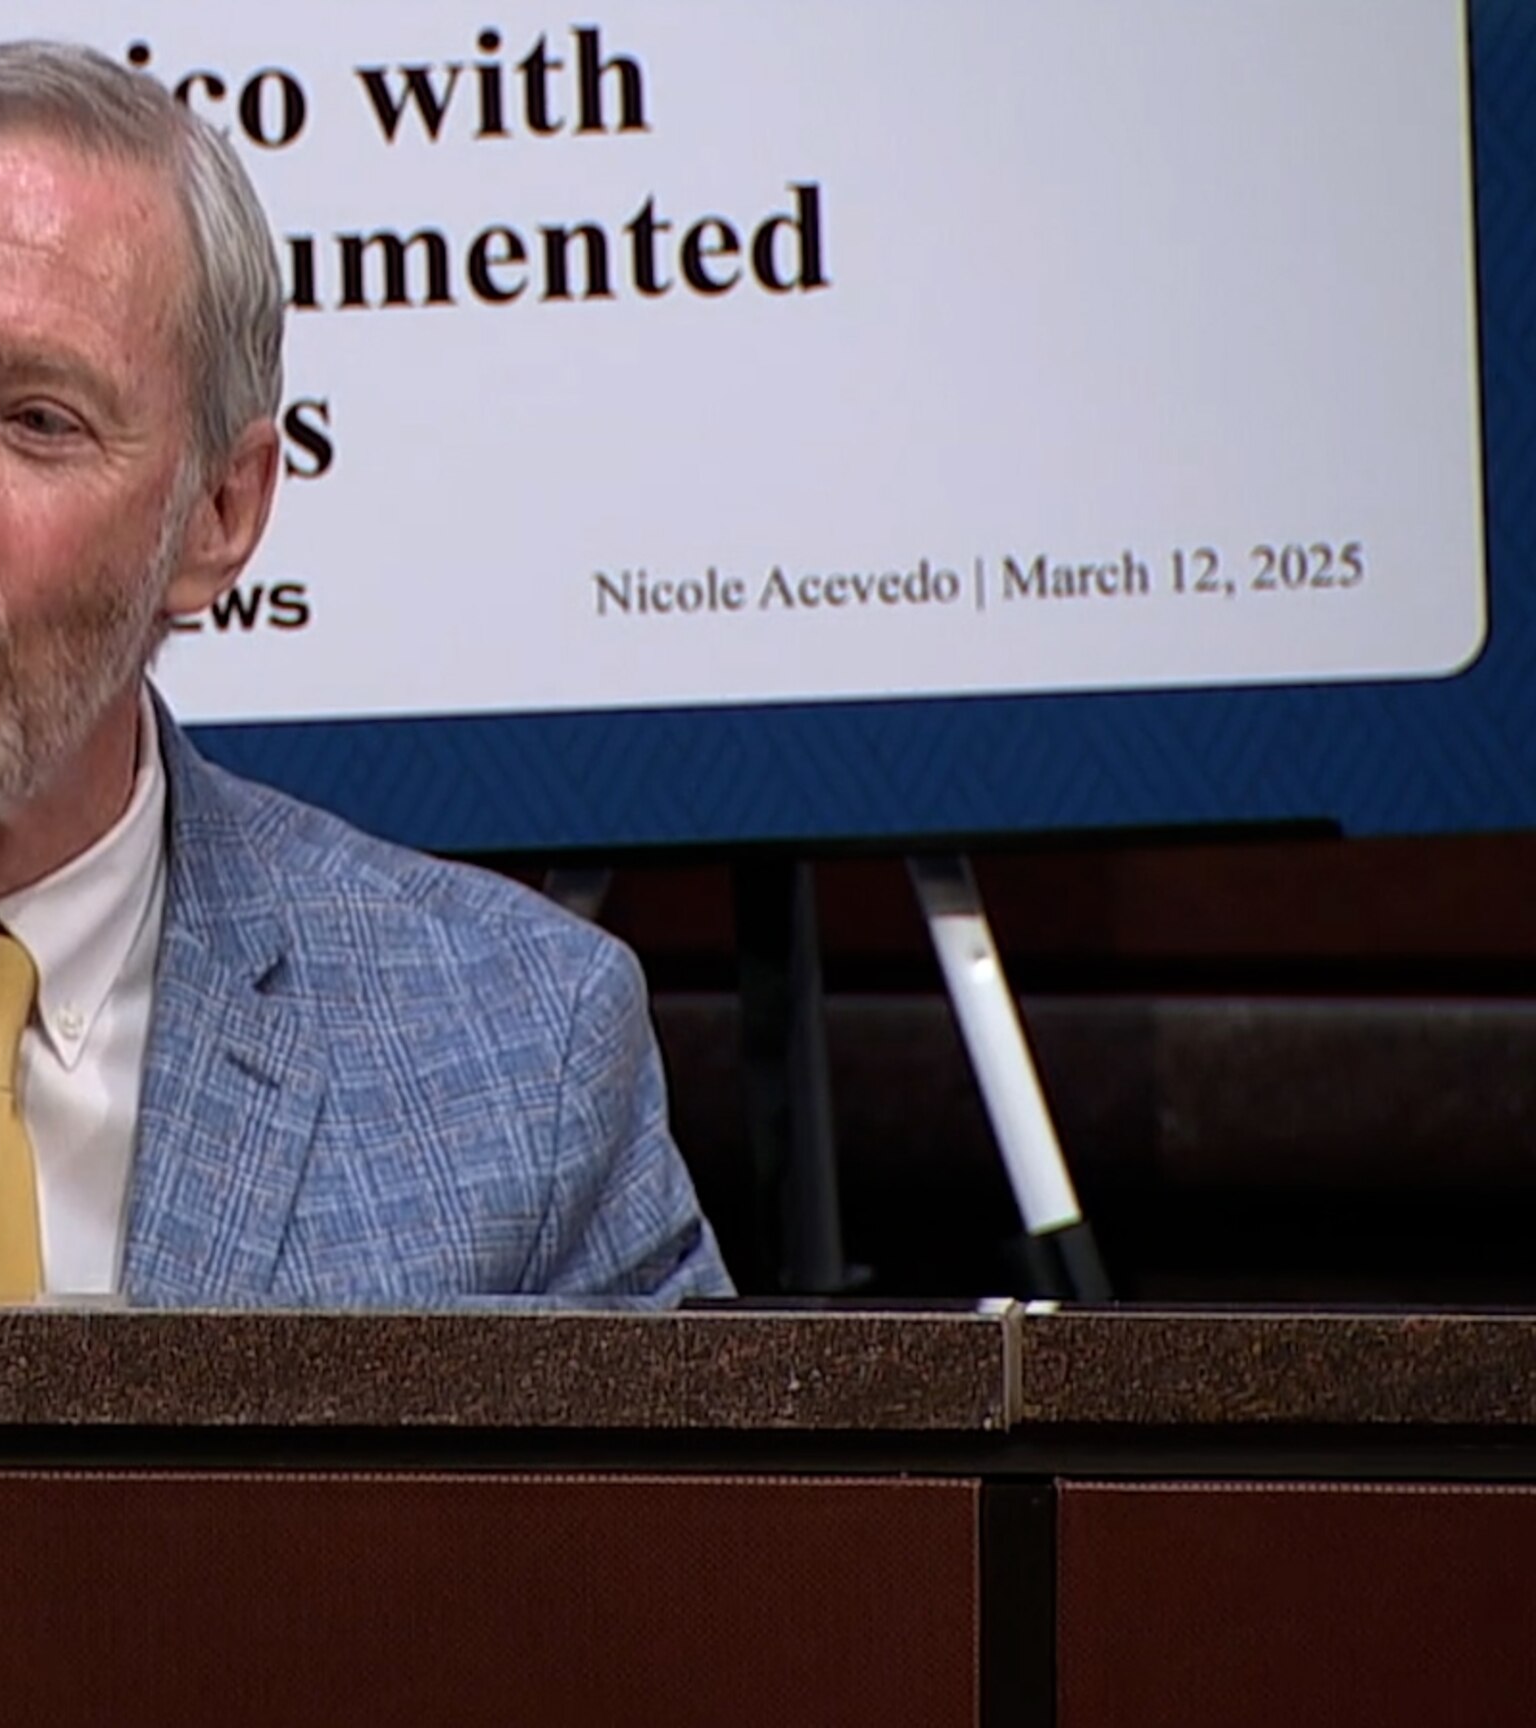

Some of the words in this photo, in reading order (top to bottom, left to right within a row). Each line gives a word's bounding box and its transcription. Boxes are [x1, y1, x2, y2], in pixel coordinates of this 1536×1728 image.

[354, 25, 650, 144] with
[170, 582, 310, 632] WS
[593, 565, 746, 616] Nicole
[758, 558, 961, 611] Acevedo
[1001, 550, 1151, 600] March
[1170, 546, 1237, 598] 12,
[1251, 541, 1365, 591] 2025
